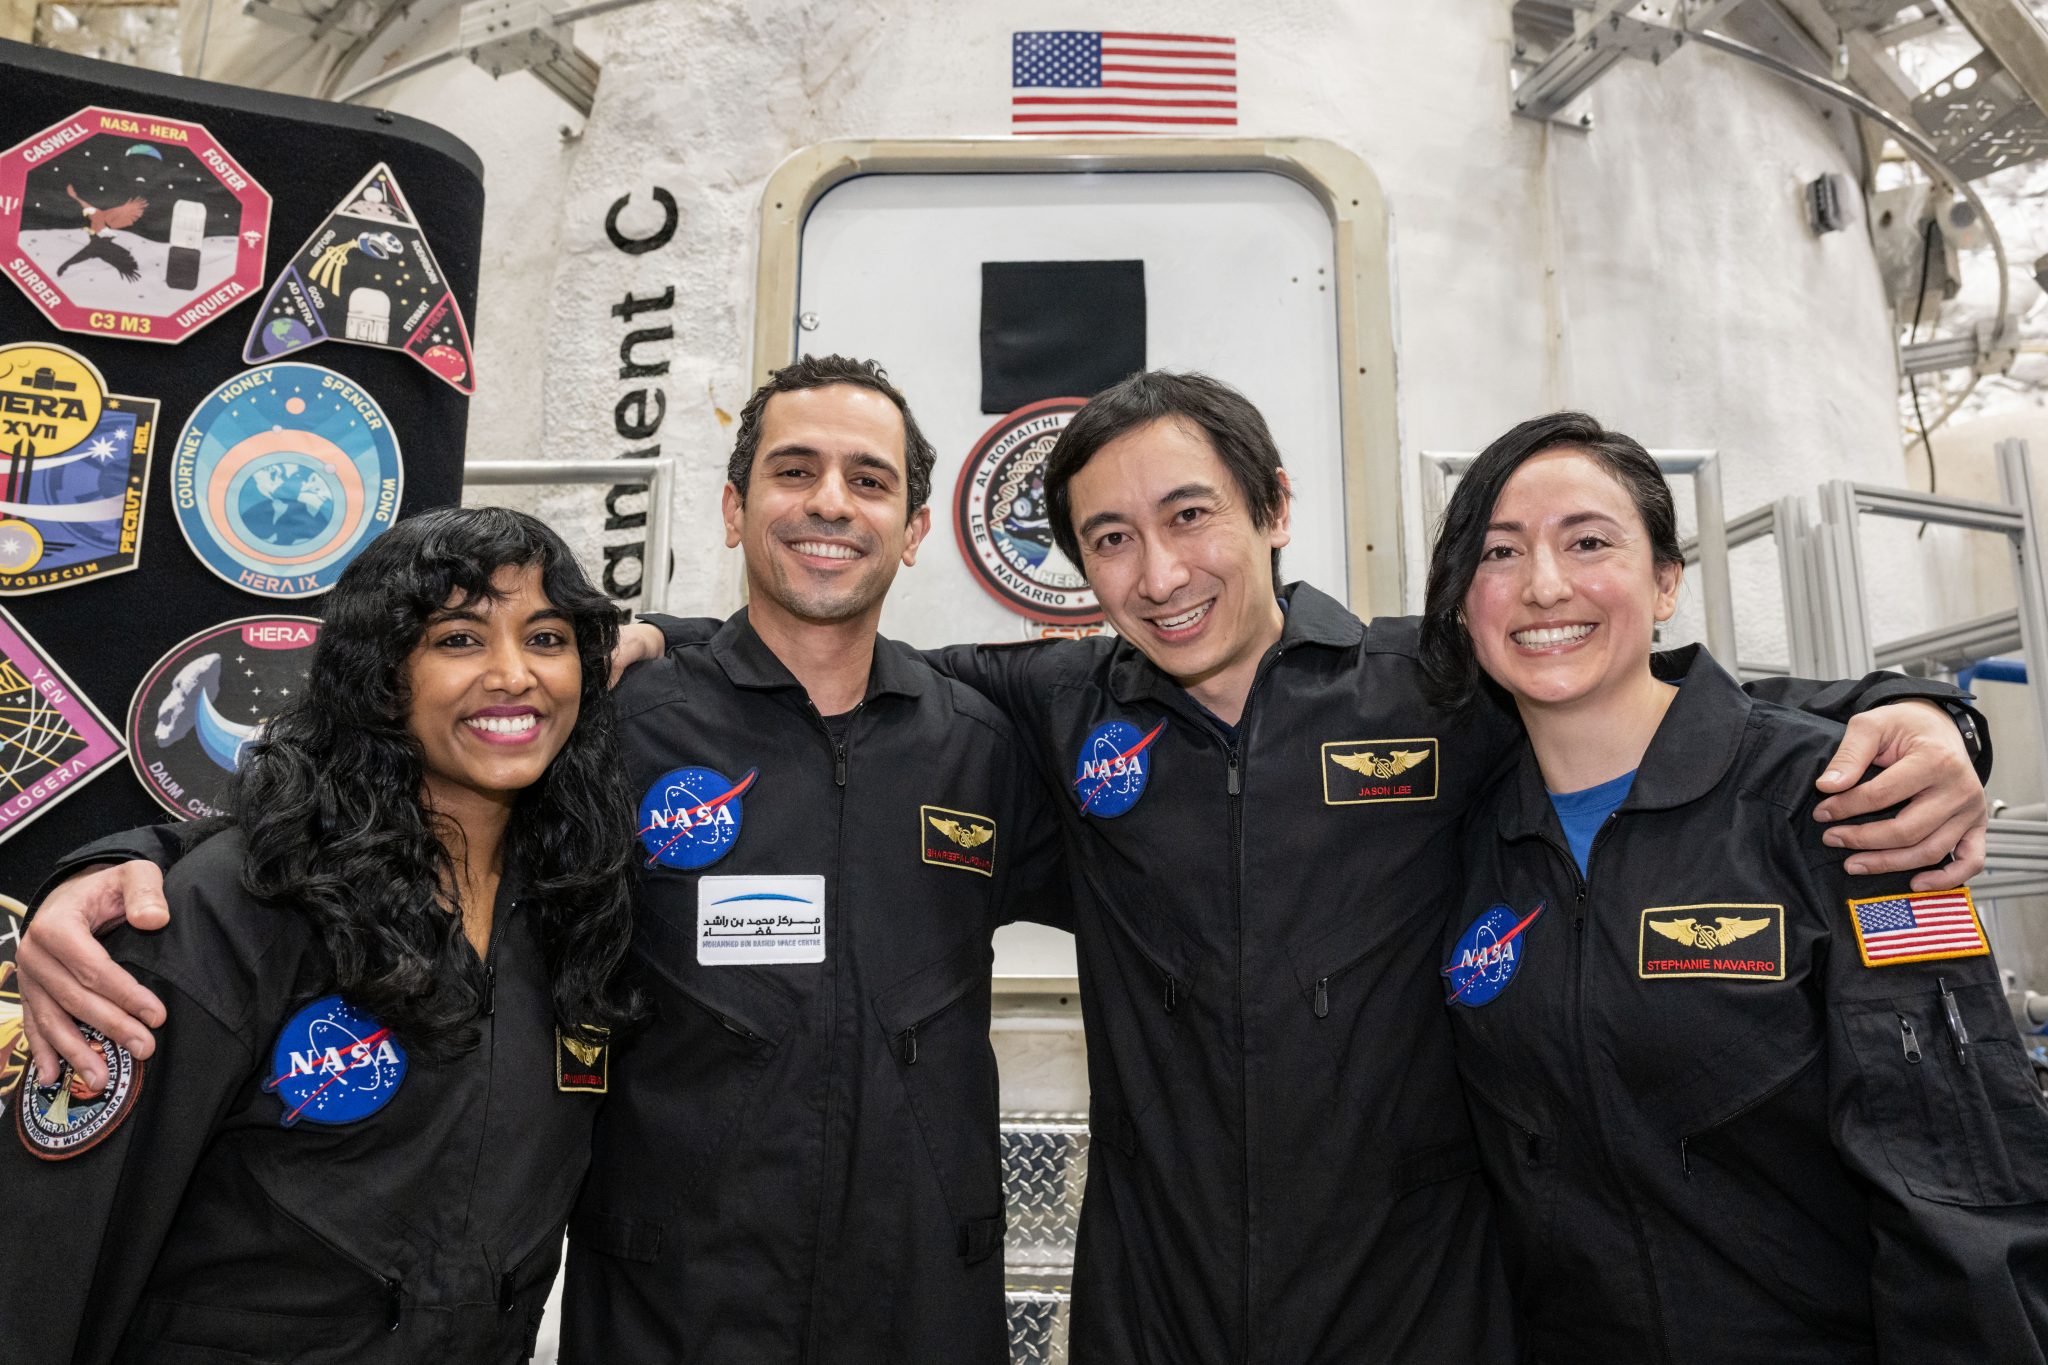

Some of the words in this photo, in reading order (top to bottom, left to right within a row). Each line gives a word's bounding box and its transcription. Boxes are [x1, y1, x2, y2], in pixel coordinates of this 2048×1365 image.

[23, 123, 89, 163] CASWELL
[101, 117, 139, 134] NASA
[150, 124, 188, 142] HERA
[201, 149, 247, 192] FOSTER
[605, 185, 679, 255] C
[9, 257, 62, 309] SURBER
[307, 286, 325, 310] GOOD
[176, 281, 245, 329] URQUIETA
[287, 281, 301, 295] AD
[294, 296, 315, 327] ASTRA
[402, 300, 430, 332] STEWART
[89, 312, 116, 330] C3
[120, 315, 151, 334] M3
[218, 370, 273, 403] HONEY
[321, 376, 382, 430] SPENCER
[0, 390, 88, 421] ERA
[3, 420, 58, 439] XVII
[133, 421, 151, 454] HEIL
[178, 426, 204, 509] COURTNEY
[975, 469, 991, 488] AL
[987, 416, 1060, 464] ROMAITHI
[375, 478, 396, 522] WONG
[119, 487, 142, 554] PECAUT
[971, 514, 988, 544] LEE
[997, 538, 1037, 578] NASA
[238, 570, 295, 593] HERA
[298, 575, 319, 590] IX
[993, 564, 1066, 605] NAVARRO
[249, 626, 310, 643] HERA
[32, 668, 68, 704] YEN
[149, 761, 185, 799] DAUM
[1081, 755, 1143, 779] NASA
[1358, 786, 1391, 796] JASON
[1393, 785, 1413, 795] LEE
[650, 804, 735, 829] NASA
[703, 915, 729, 928] راشد
[730, 917, 744, 928] بن
[747, 917, 775, 926] محمد
[1459, 941, 1515, 968] NASA
[1647, 960, 1711, 972] STEPHANIE
[1713, 960, 1775, 972] NAVARRO
[288, 1040, 400, 1077] NASA
[24, 1111, 50, 1145] NAVARRO
[41, 1118, 66, 1134] HERA
[63, 1095, 123, 1146] WIJESEKARA
